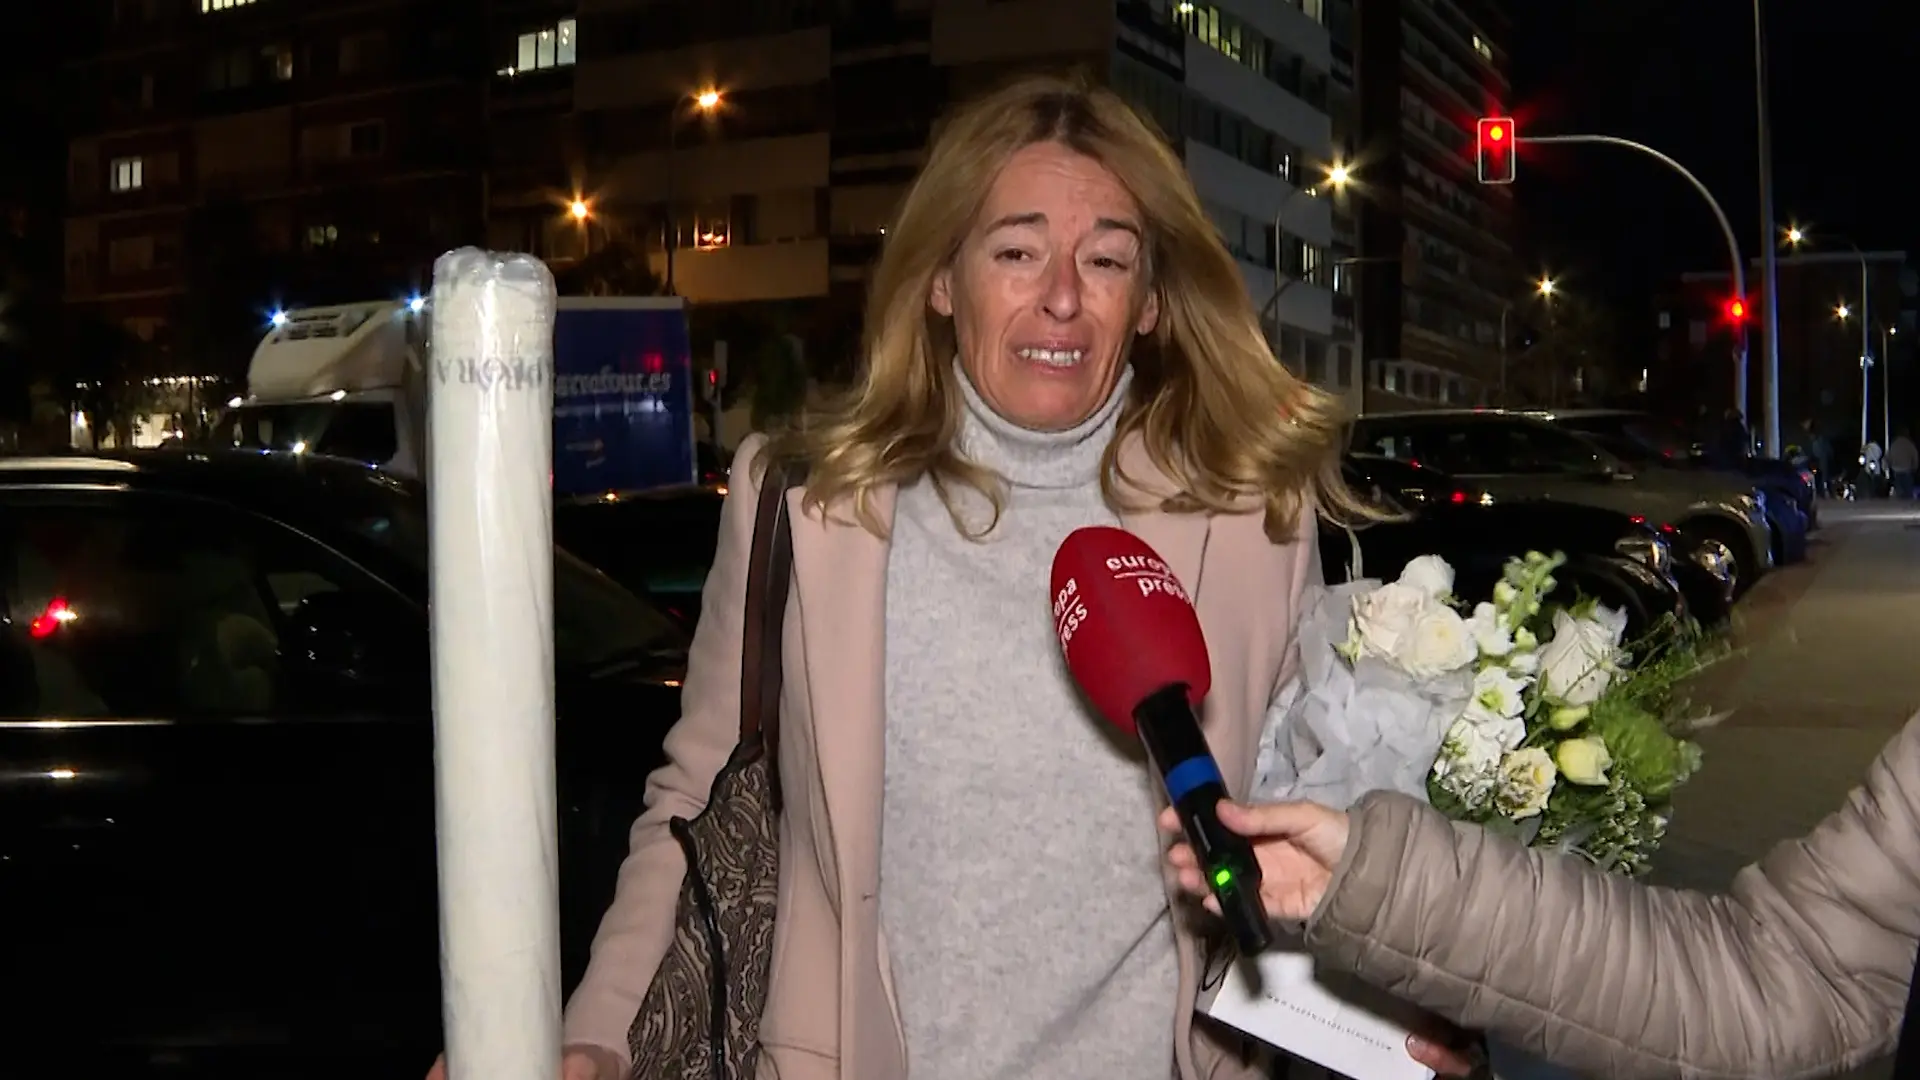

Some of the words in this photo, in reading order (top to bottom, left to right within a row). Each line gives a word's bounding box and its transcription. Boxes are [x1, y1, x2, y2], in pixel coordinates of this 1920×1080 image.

[554, 364, 671, 397] arrefour.es
[1054, 578, 1077, 617] opa
[1061, 603, 1088, 652] ress
